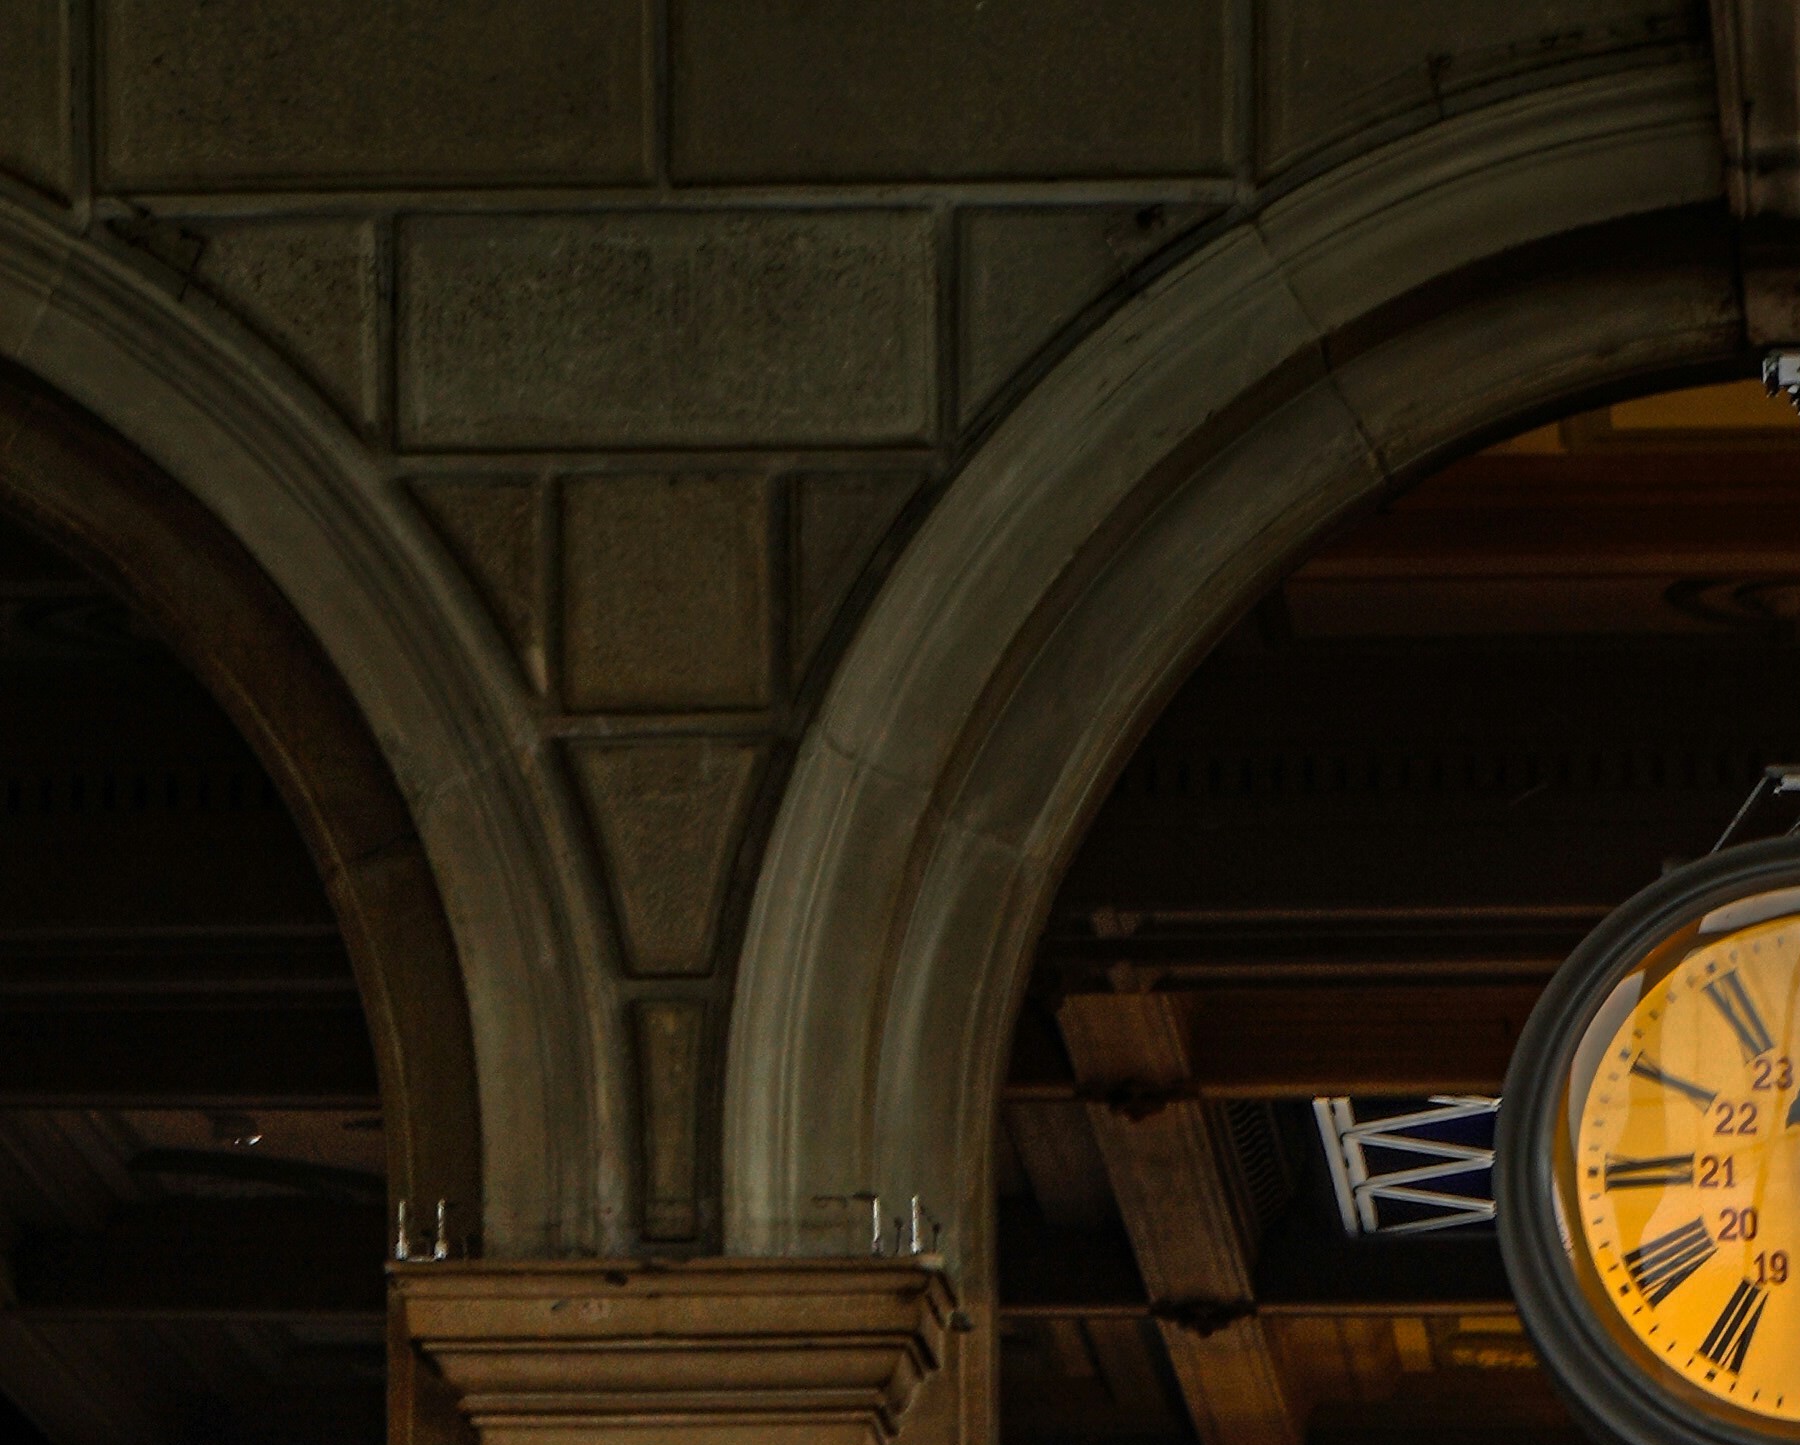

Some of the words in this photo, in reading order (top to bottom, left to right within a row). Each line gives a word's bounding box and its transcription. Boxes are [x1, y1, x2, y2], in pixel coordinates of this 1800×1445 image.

[1752, 1058, 1793, 1091] 23
[1714, 1102, 1758, 1136] 22
[1699, 1154, 1736, 1188] 21
[1717, 1207, 1758, 1242] 20
[1753, 1250, 1789, 1286] 19
